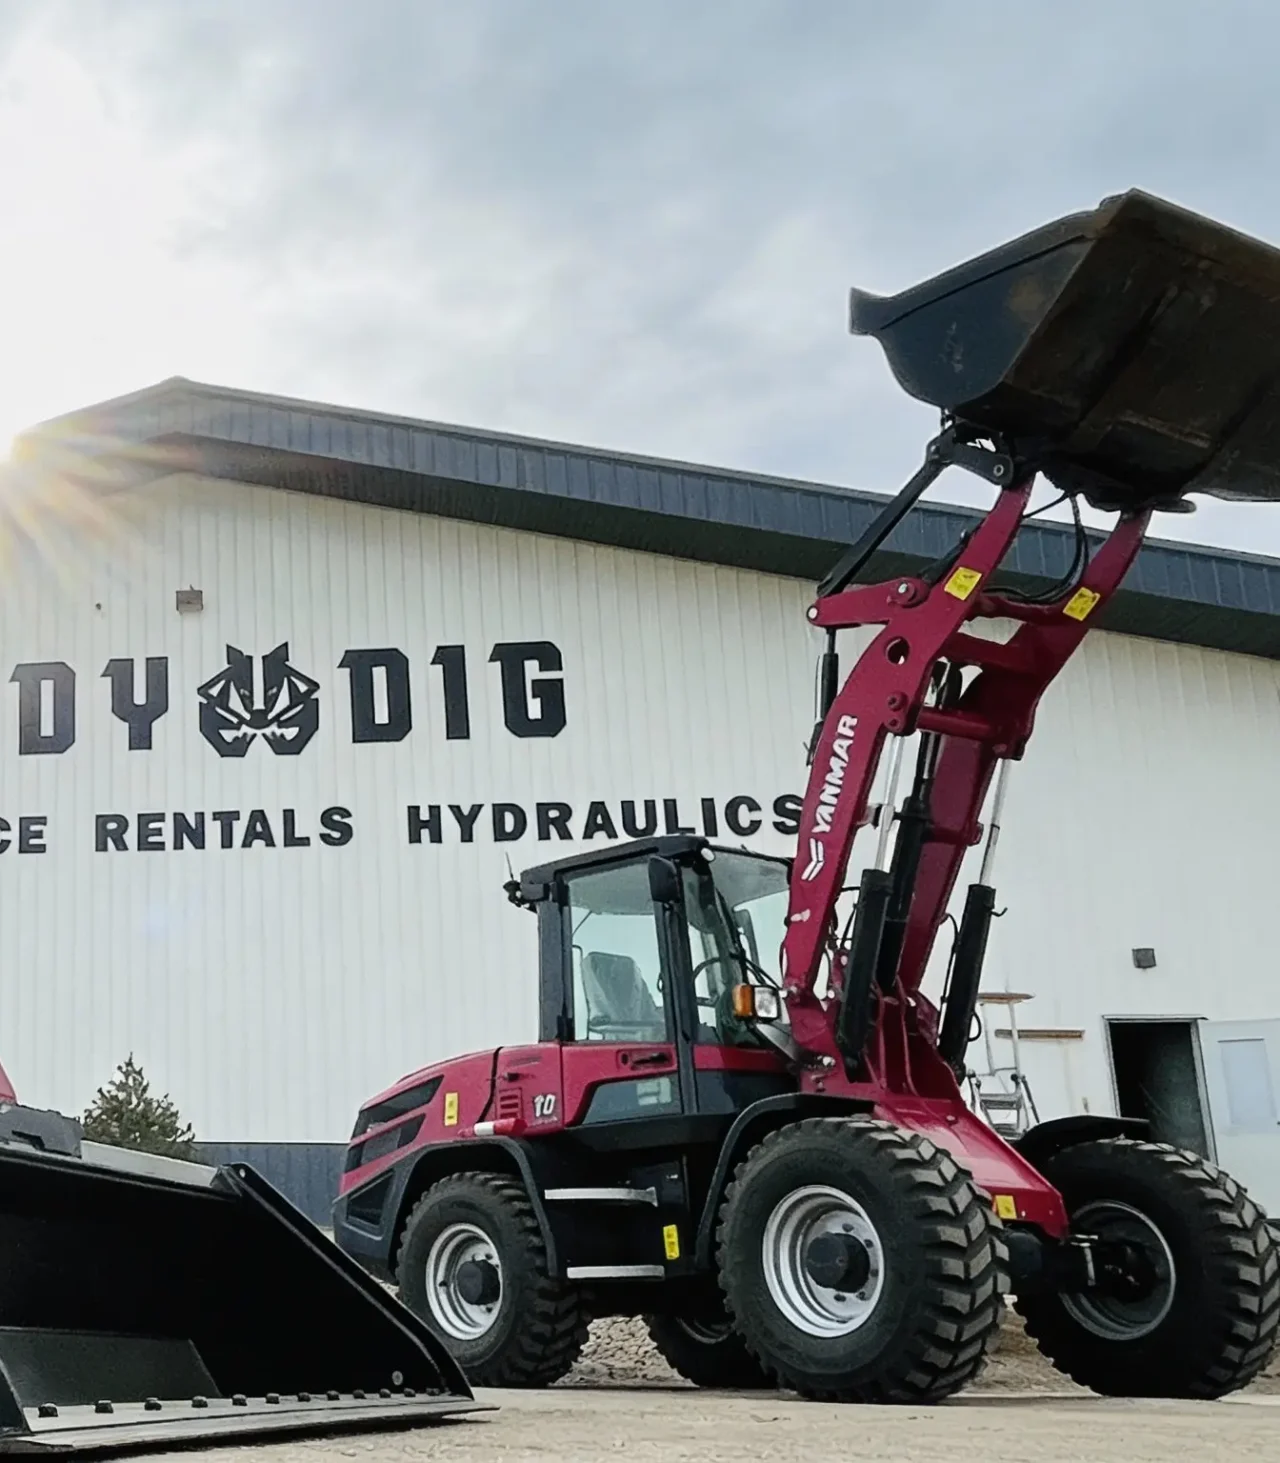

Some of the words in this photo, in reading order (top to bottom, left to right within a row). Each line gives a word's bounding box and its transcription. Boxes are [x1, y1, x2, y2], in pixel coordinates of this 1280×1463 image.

[336, 640, 567, 744] DIG
[94, 806, 355, 852] RENTALS
[407, 793, 804, 845] HYDRAULICS
[811, 714, 858, 834] YANMAR
